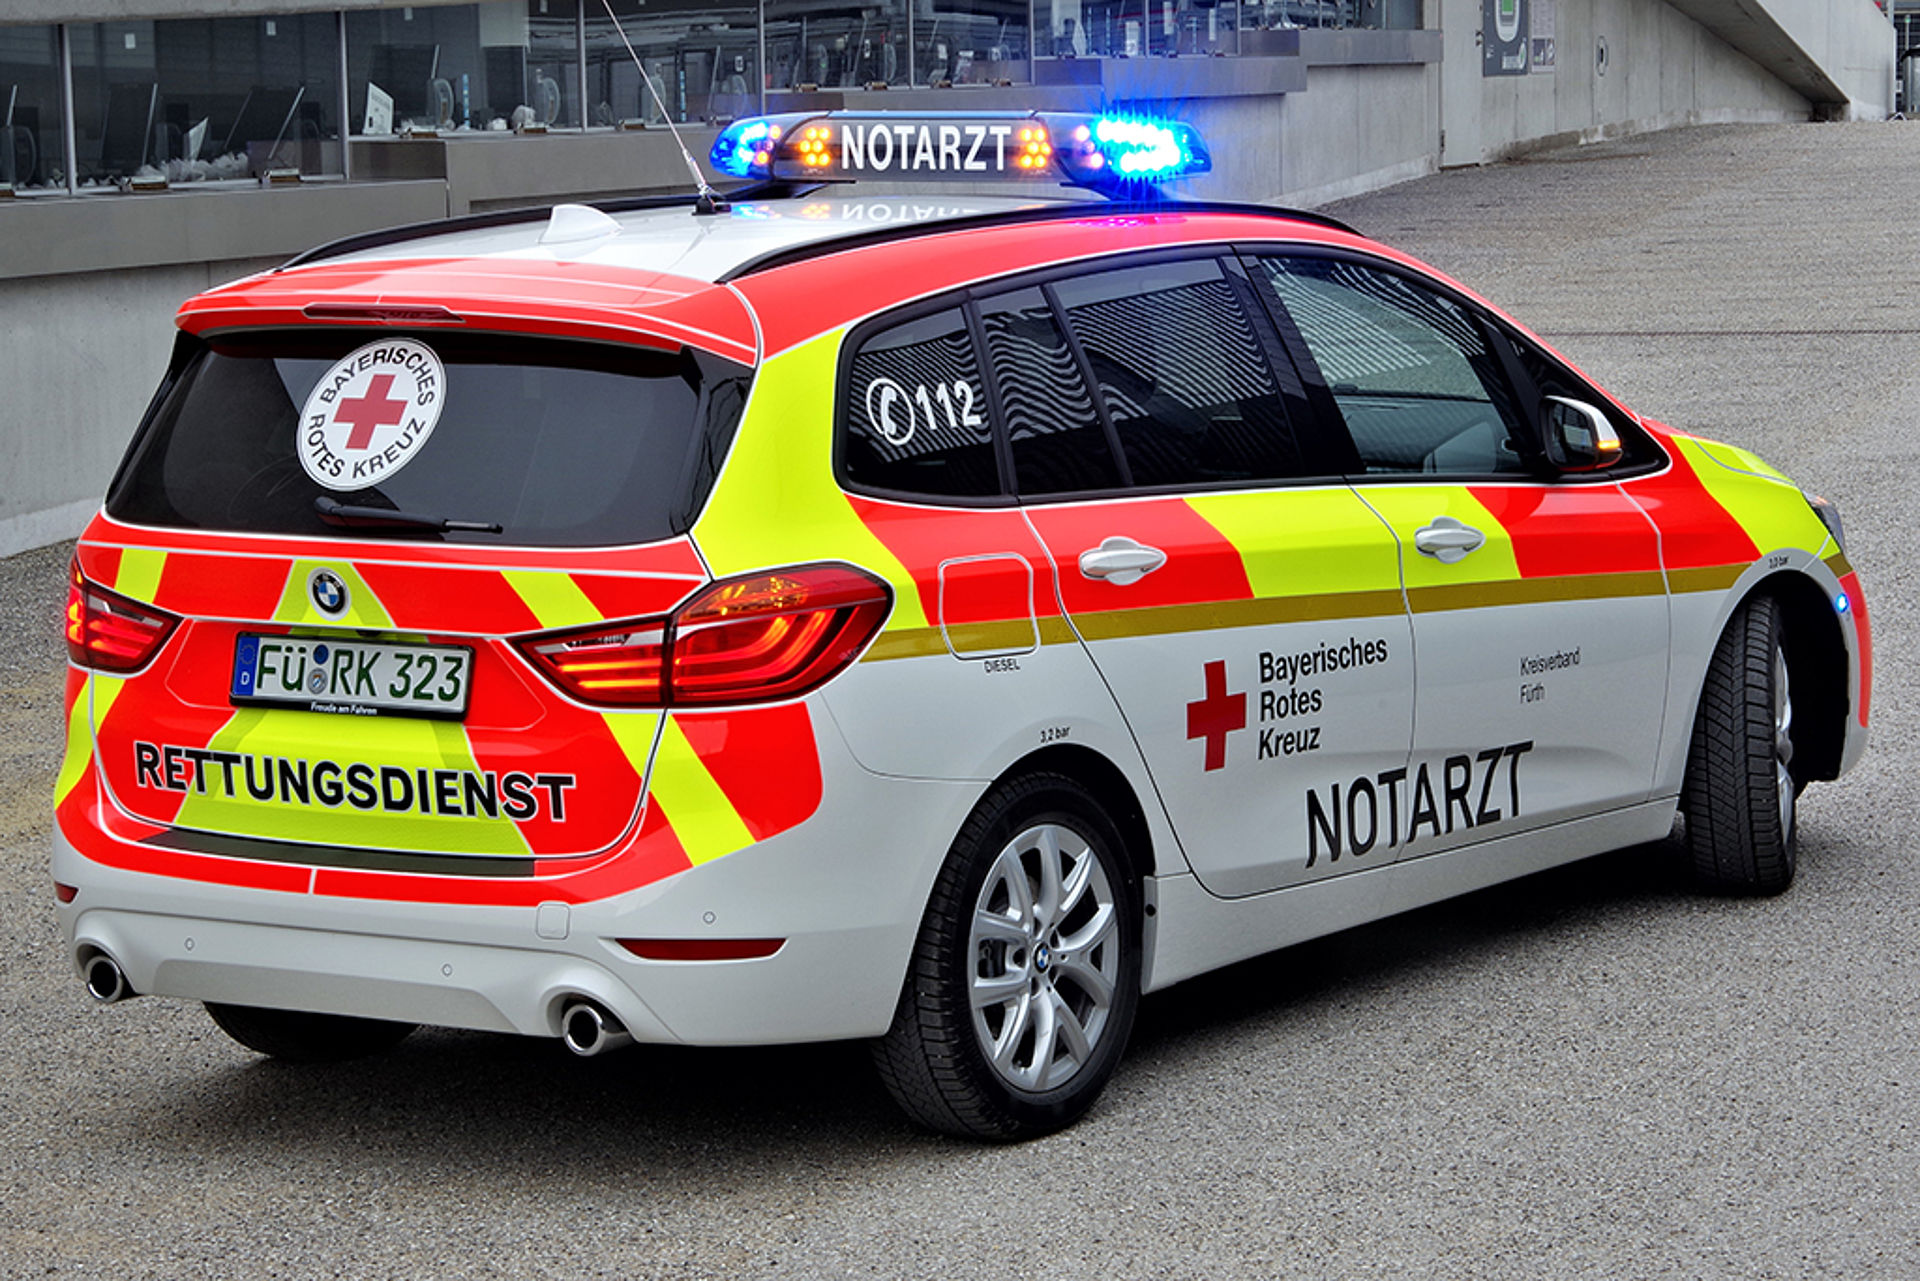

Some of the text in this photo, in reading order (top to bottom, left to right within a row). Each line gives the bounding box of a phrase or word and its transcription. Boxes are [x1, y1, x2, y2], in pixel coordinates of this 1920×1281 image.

[841, 124, 1012, 171] NOTARZT
[320, 347, 436, 406] BAYERISCHES
[915, 380, 982, 431] 112
[307, 413, 426, 478] ROTES KREUZ
[255, 643, 464, 702] FÜ RK 323
[984, 659, 1020, 673] DIESEL
[1258, 637, 1389, 686] Bayerisches
[1519, 645, 1581, 677] Kreisverband
[1259, 687, 1323, 723] Rotes
[1519, 682, 1546, 704] Fürth
[1257, 726, 1322, 761] Kreuz
[133, 740, 577, 823] RETTUNGSDIENST
[1305, 739, 1535, 870] NOTARZT
